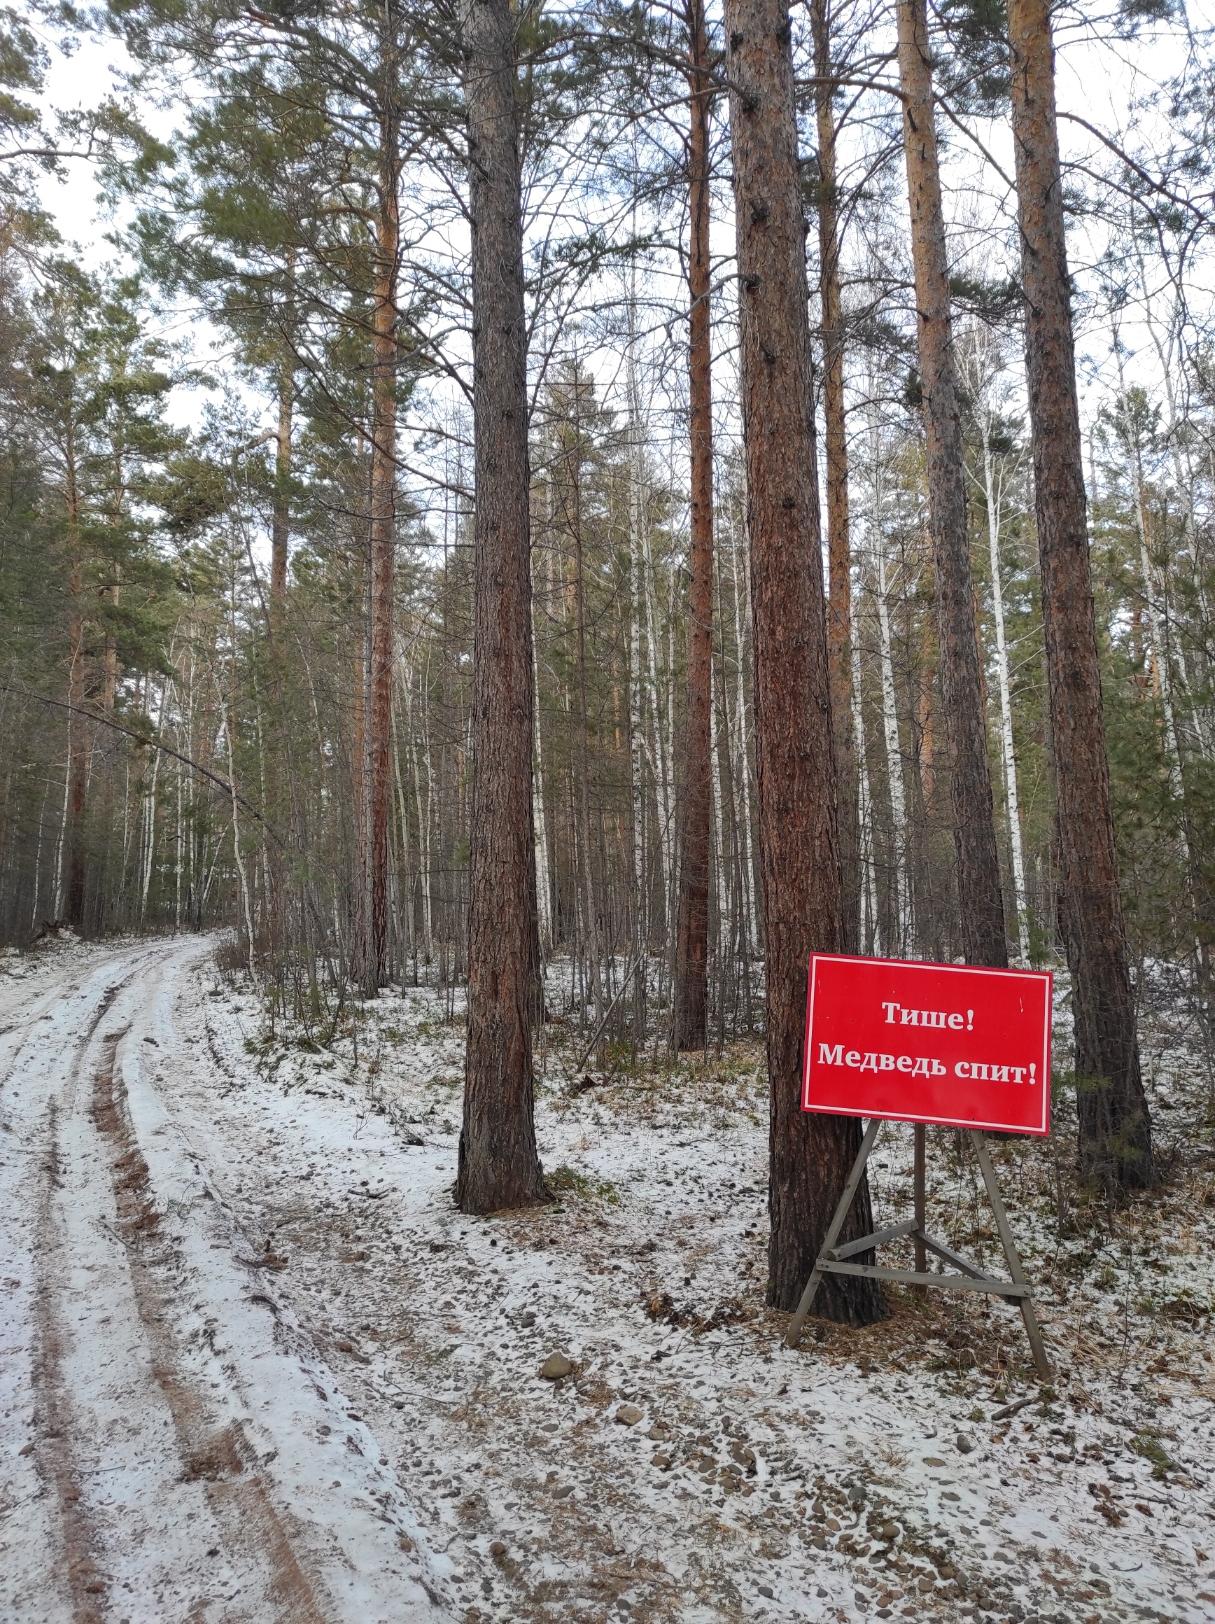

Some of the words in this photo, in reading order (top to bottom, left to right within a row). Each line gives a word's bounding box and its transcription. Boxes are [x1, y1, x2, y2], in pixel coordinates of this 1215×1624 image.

[881, 1002, 975, 1031] Тише!
[817, 1043, 947, 1078] Медведь
[954, 1061, 1037, 1085] спит!
